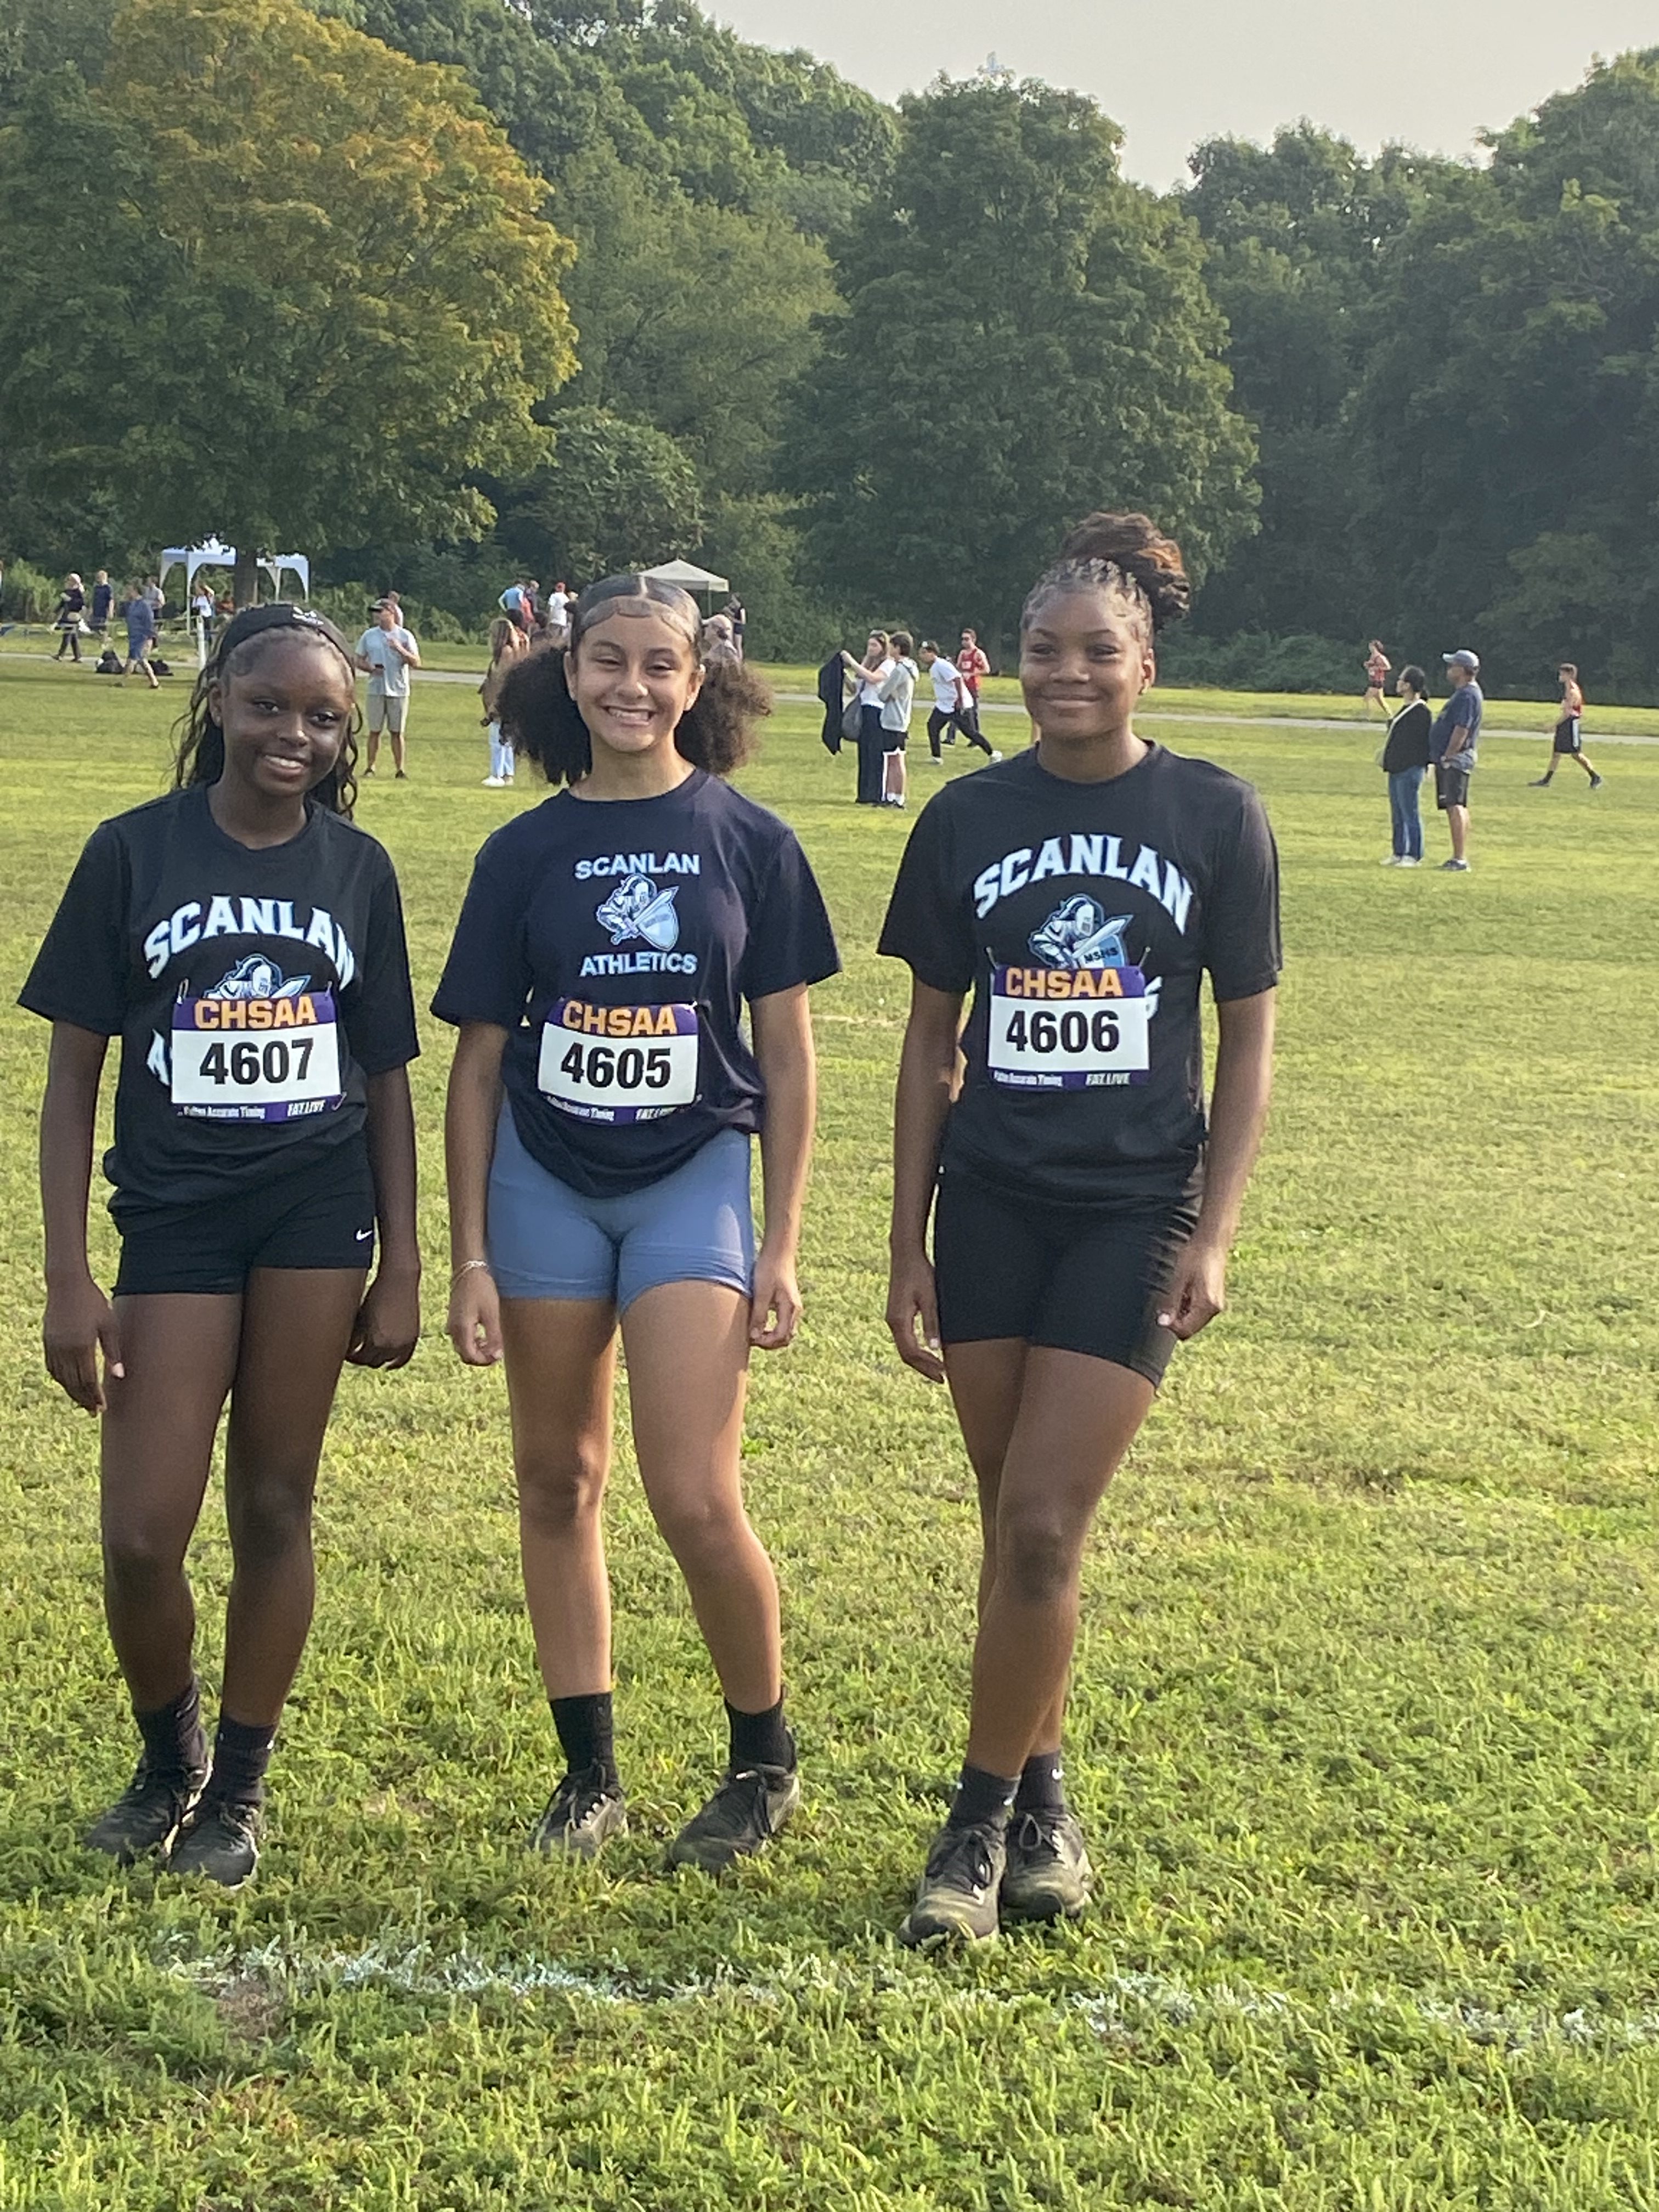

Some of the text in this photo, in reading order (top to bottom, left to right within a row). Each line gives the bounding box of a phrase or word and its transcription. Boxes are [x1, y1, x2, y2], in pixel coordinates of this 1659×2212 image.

[574, 853, 701, 879] SCANLAN
[973, 833, 1193, 935] SCANLAN
[143, 895, 355, 992] SCANLAN
[580, 951, 698, 977] ATHLETICS
[1005, 967, 1124, 998] CHSAA
[193, 996, 317, 1029] CHSAA
[562, 1000, 678, 1036] CHSAA
[1006, 1010, 1120, 1053] 4606
[199, 1037, 314, 1085] 4607
[560, 1042, 672, 1089] 4605
